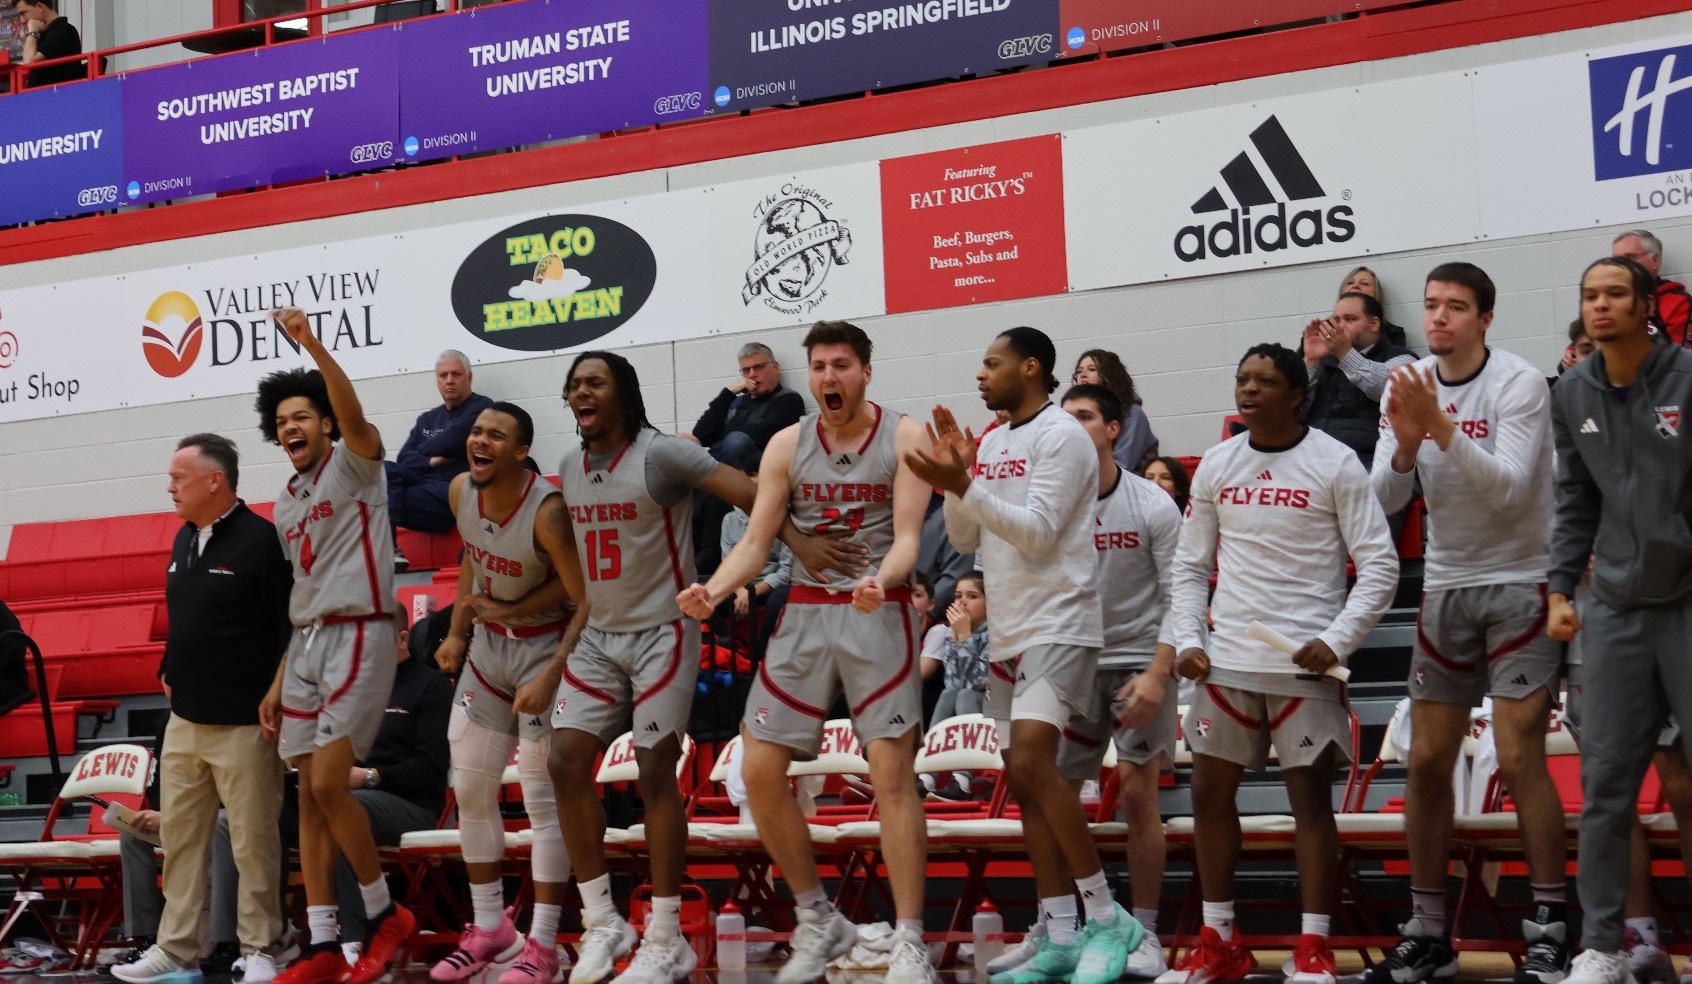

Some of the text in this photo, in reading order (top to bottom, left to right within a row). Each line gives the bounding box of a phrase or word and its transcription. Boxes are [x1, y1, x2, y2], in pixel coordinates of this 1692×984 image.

[750, 0, 1011, 53] ILLINOIS SPRINGFIELD
[1092, 19, 1160, 41] DIVISION II
[469, 20, 630, 67] TRUMAN STATE
[997, 33, 1053, 59] GLVC
[486, 57, 613, 97] UNIVERSITY
[736, 79, 796, 99] DIVISION II
[157, 68, 359, 121] SOUTHWEST BAPTIST
[654, 91, 702, 115] GLVC
[201, 108, 314, 144] UNIVERSITY
[0, 129, 103, 164] UNIVERSITY
[351, 141, 393, 164] GLVC
[423, 131, 477, 150] DIVISION II
[144, 176, 192, 194] DIVISION II
[943, 164, 996, 181] Featuring
[1665, 174, 1684, 185] AN
[78, 185, 118, 206] GLVC
[753, 183, 834, 219] The Original
[910, 188, 947, 210] FAT
[933, 229, 1014, 249] Beef, Burgers,
[1173, 202, 1356, 263] adidas
[505, 226, 596, 266] TACO
[753, 225, 836, 276] OLD WORLD PIZZA
[929, 245, 1019, 270] Pasta, Subs and
[204, 268, 381, 317] VALLEY VIEW
[954, 274, 996, 287] more...
[483, 285, 624, 333] HEAVEN
[804, 288, 828, 314] Park
[28, 371, 80, 402] Shop
[977, 459, 1027, 480] FLYERS
[801, 483, 889, 503] FLYERS
[1219, 486, 1311, 509] FLYERS
[568, 502, 638, 524] FLYERS
[1094, 531, 1140, 551] ERS
[465, 541, 523, 578] FLYERS
[584, 528, 622, 581] 15
[924, 722, 999, 758] LEWIS
[76, 751, 139, 782] LEWIS
